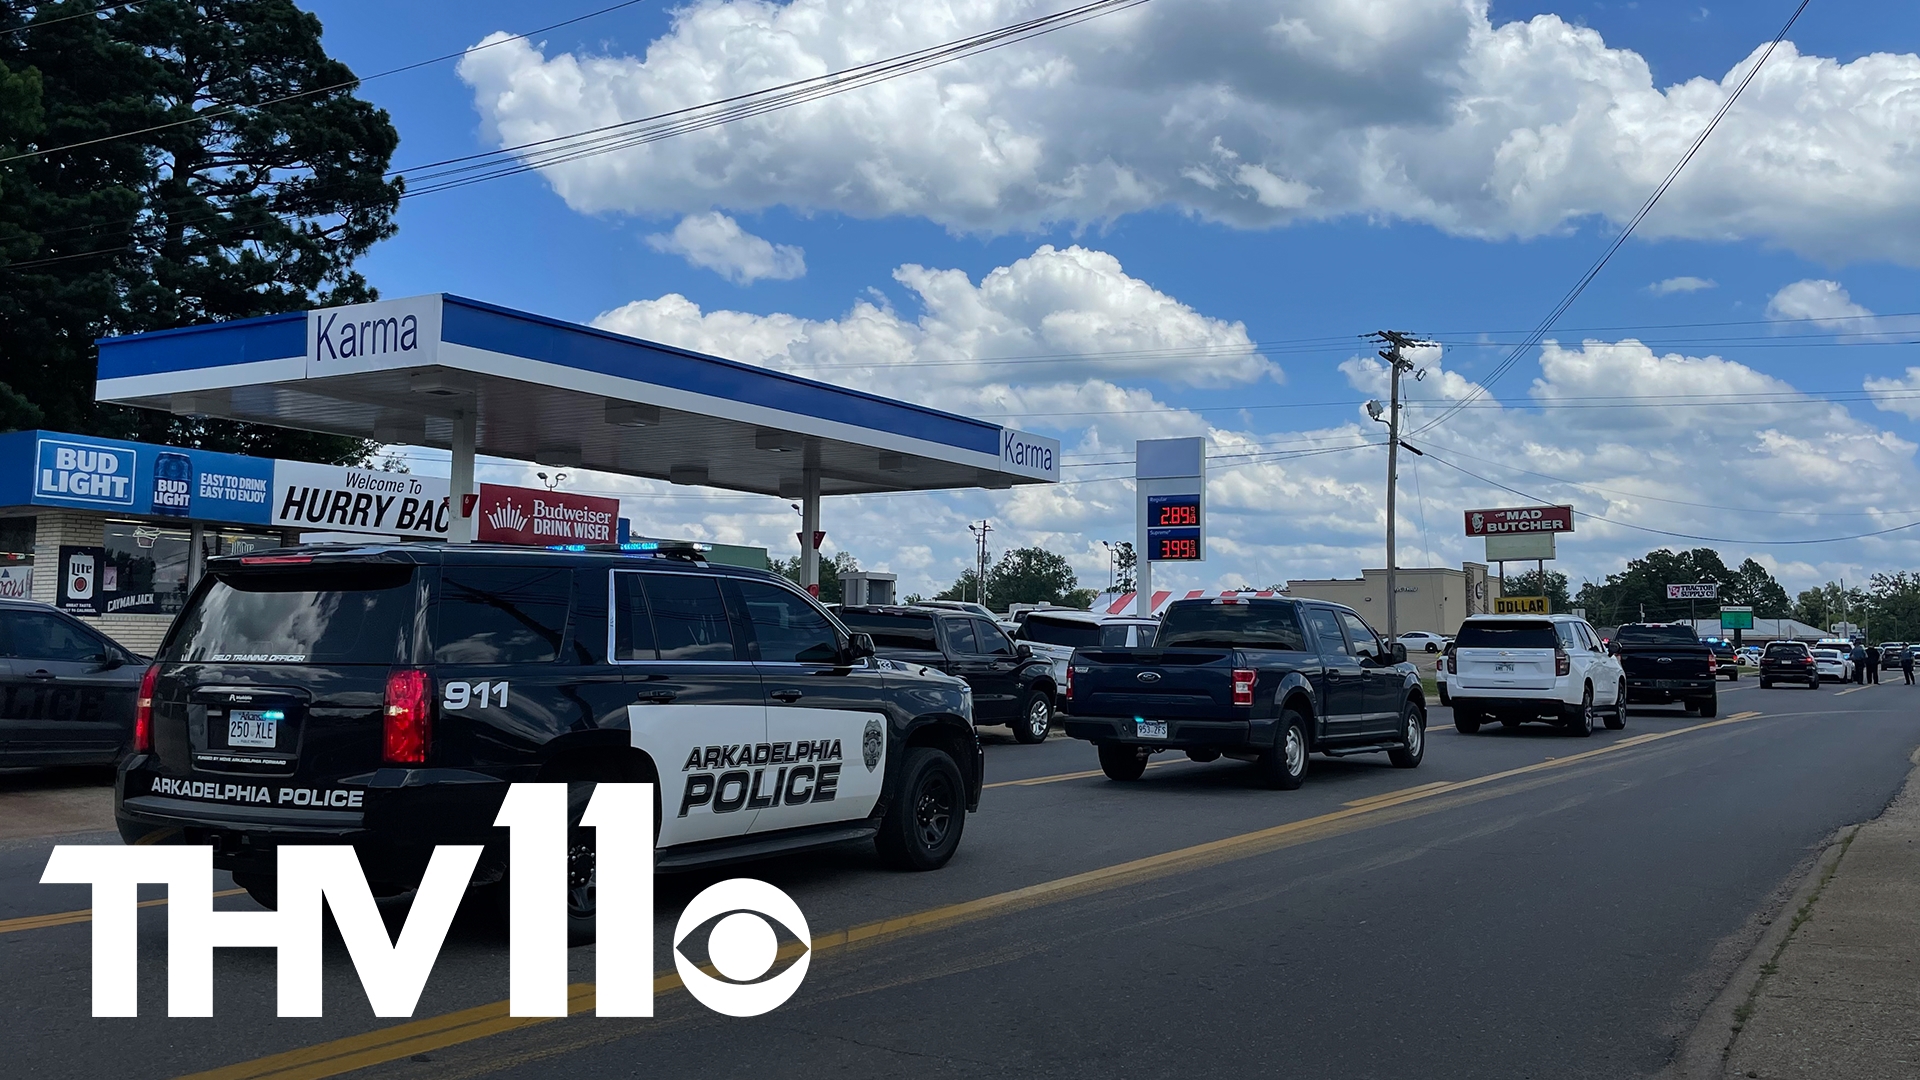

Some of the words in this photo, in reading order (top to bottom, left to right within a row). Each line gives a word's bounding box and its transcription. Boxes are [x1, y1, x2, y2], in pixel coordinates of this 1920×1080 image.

[316, 312, 418, 362] Karma
[1004, 431, 1052, 471] Karma
[56, 447, 119, 475] BUD
[42, 469, 129, 498] LIGHT
[157, 479, 188, 494] BUD
[200, 473, 225, 487] EASY
[226, 475, 238, 488] TO
[239, 477, 267, 492] DRINK
[345, 472, 405, 493] Welcome
[409, 479, 422, 495] To
[154, 491, 190, 506] LIGHT
[200, 485, 224, 499] EASY
[225, 488, 237, 500] TO
[238, 489, 266, 503] ENJOY
[279, 485, 396, 528] HURRY
[395, 497, 450, 533] BAC
[532, 499, 612, 524] Budweiser
[1160, 506, 1190, 525] 2.89
[1506, 510, 1542, 520] MAD
[533, 518, 572, 538] DRINK
[573, 522, 610, 541] WISER
[1486, 520, 1564, 532] BUTCHER
[1161, 540, 1190, 558] 3.99
[71, 562, 93, 576] Lite
[107, 595, 135, 612] CAYMAN
[135, 593, 155, 605] JACK
[1497, 599, 1545, 613] DOLLAR
[269, 654, 306, 662] OFFICER
[443, 681, 509, 710] 911
[230, 721, 250, 738] 250
[255, 722, 274, 739] XLE
[1138, 725, 1151, 734] 953
[682, 738, 843, 772] ARKADELPHIA
[151, 777, 271, 804] ARKADELPHIA
[278, 787, 365, 808] POLICE
[677, 763, 843, 818] POLICE
